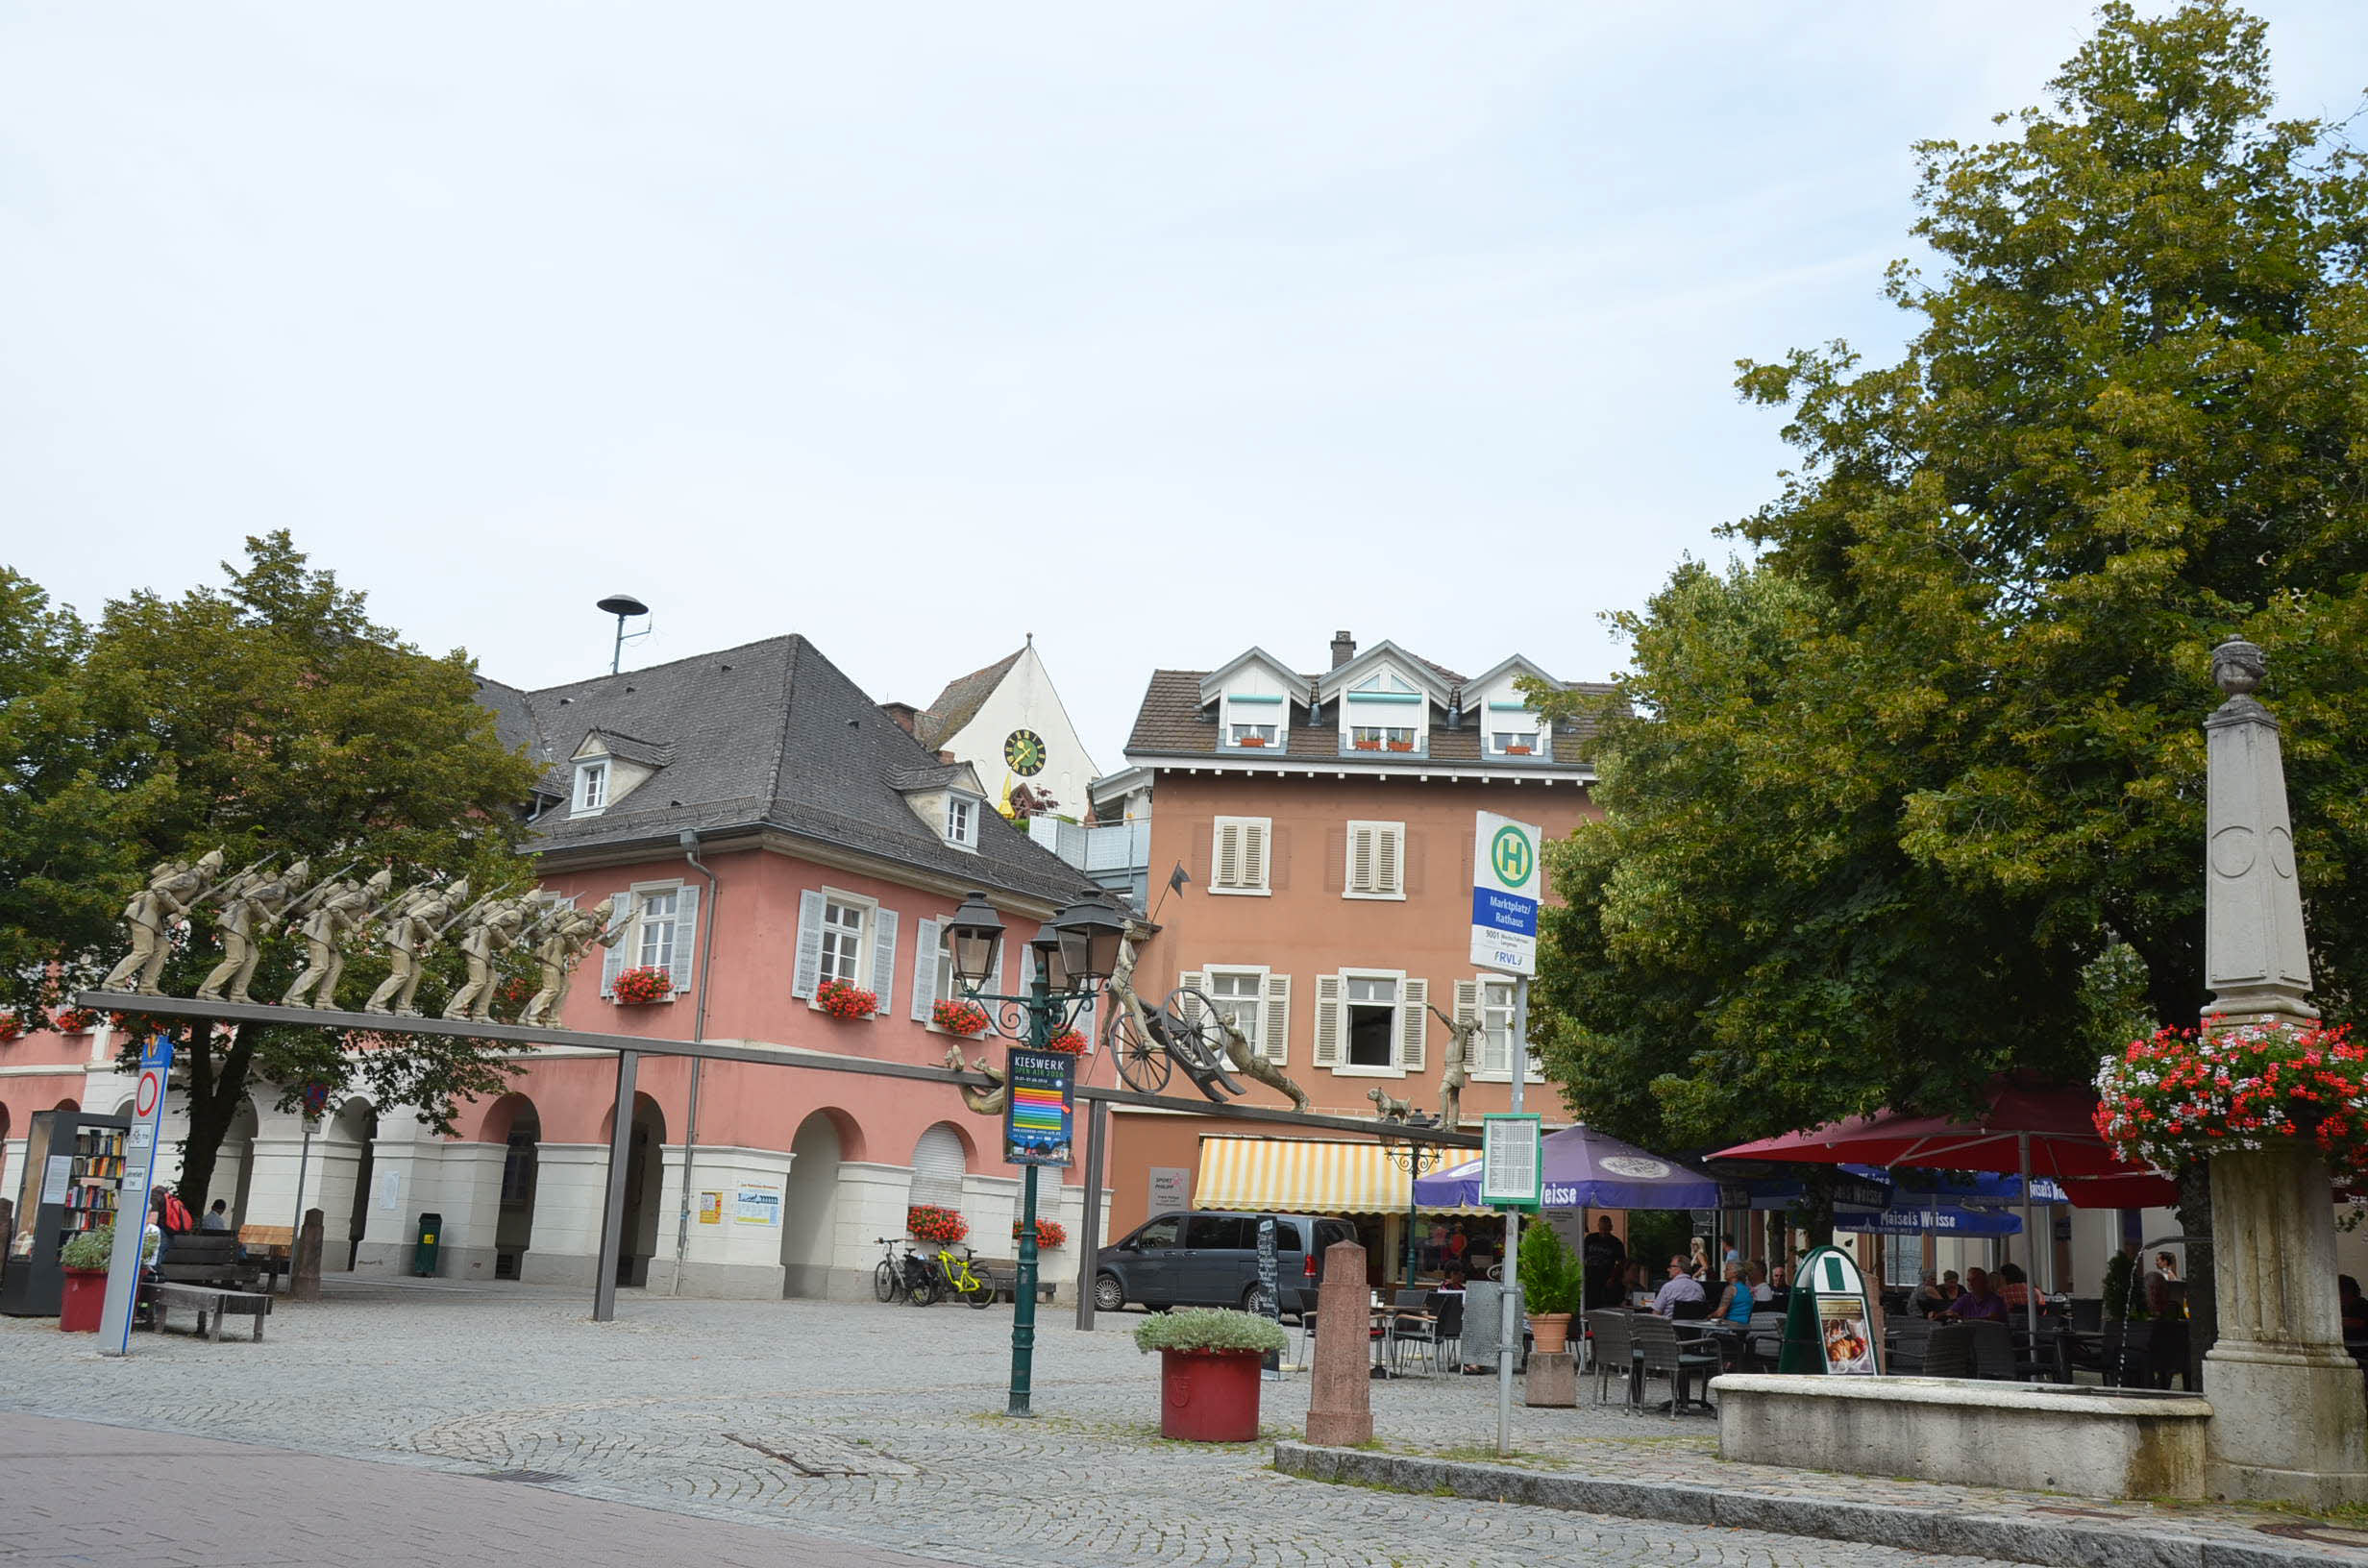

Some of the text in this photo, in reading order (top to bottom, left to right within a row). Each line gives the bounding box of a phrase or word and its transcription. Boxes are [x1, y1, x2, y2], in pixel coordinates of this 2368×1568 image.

[1490, 895, 1531, 915] Marktplatz/
[1495, 912, 1524, 928] Rathaus
[1015, 1056, 1064, 1070] KIESWERK
[1015, 1066, 1030, 1075] OPEN
[1032, 1068, 1045, 1077] AIR
[1880, 1209, 1918, 1227] Maisel's
